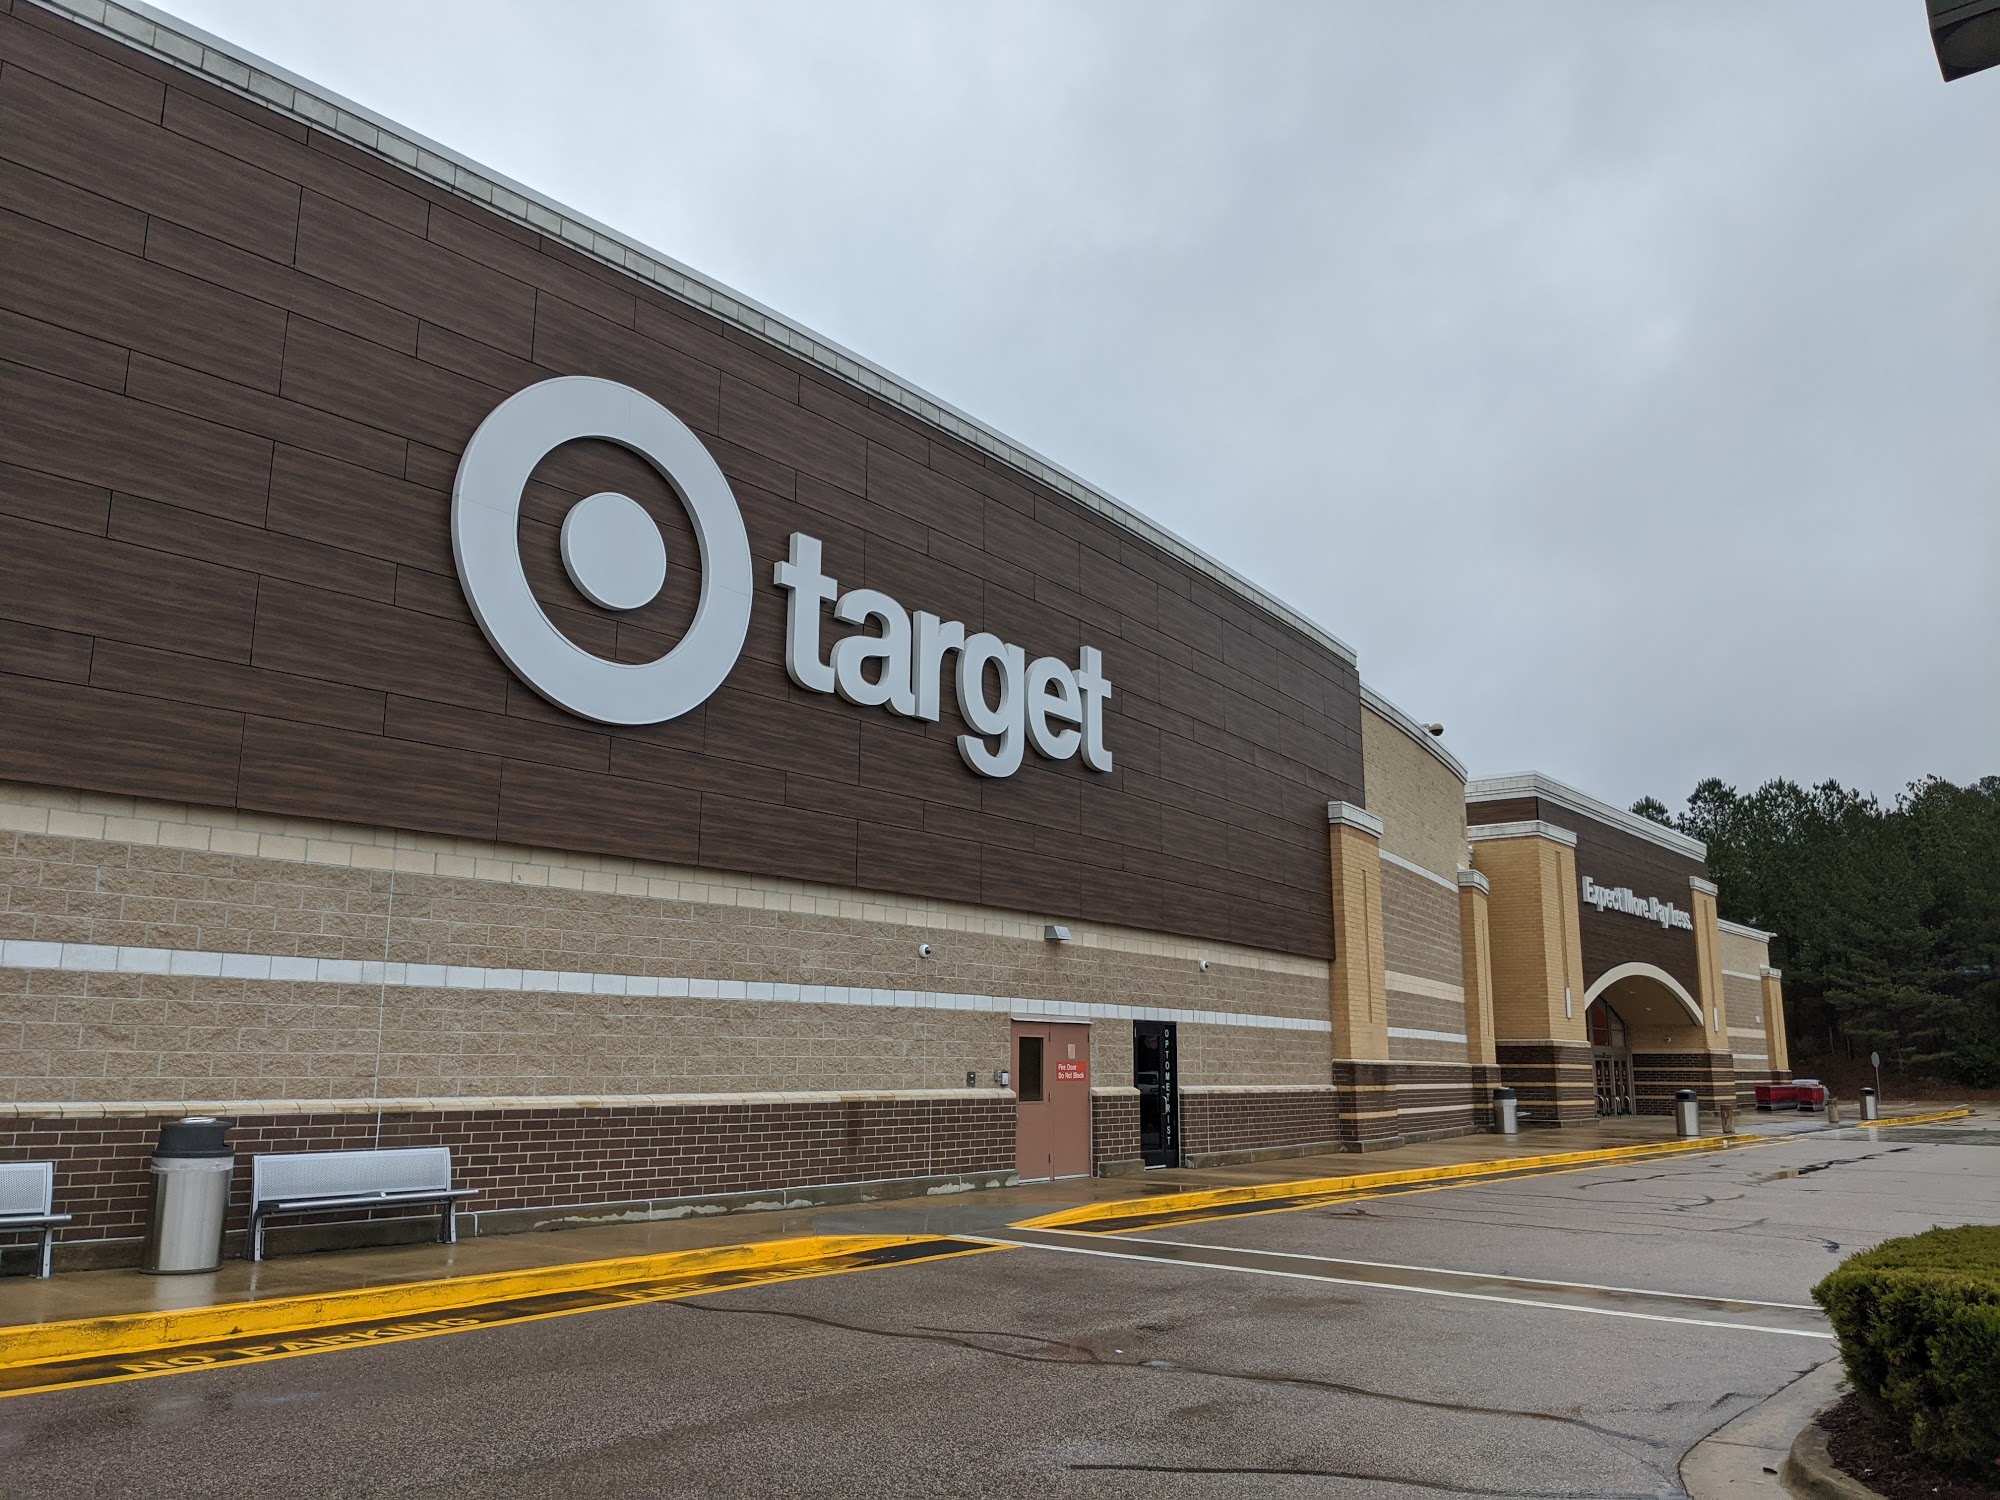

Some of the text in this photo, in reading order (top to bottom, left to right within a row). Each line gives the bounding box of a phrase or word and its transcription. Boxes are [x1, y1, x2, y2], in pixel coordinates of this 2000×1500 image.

[773, 532, 1113, 778] target
[1582, 875, 1623, 912] Expect
[1649, 897, 1669, 929] Pay
[1058, 1063, 1077, 1071] Fire Door
[115, 1356, 217, 1374] NO
[231, 1317, 481, 1358] PARKING
